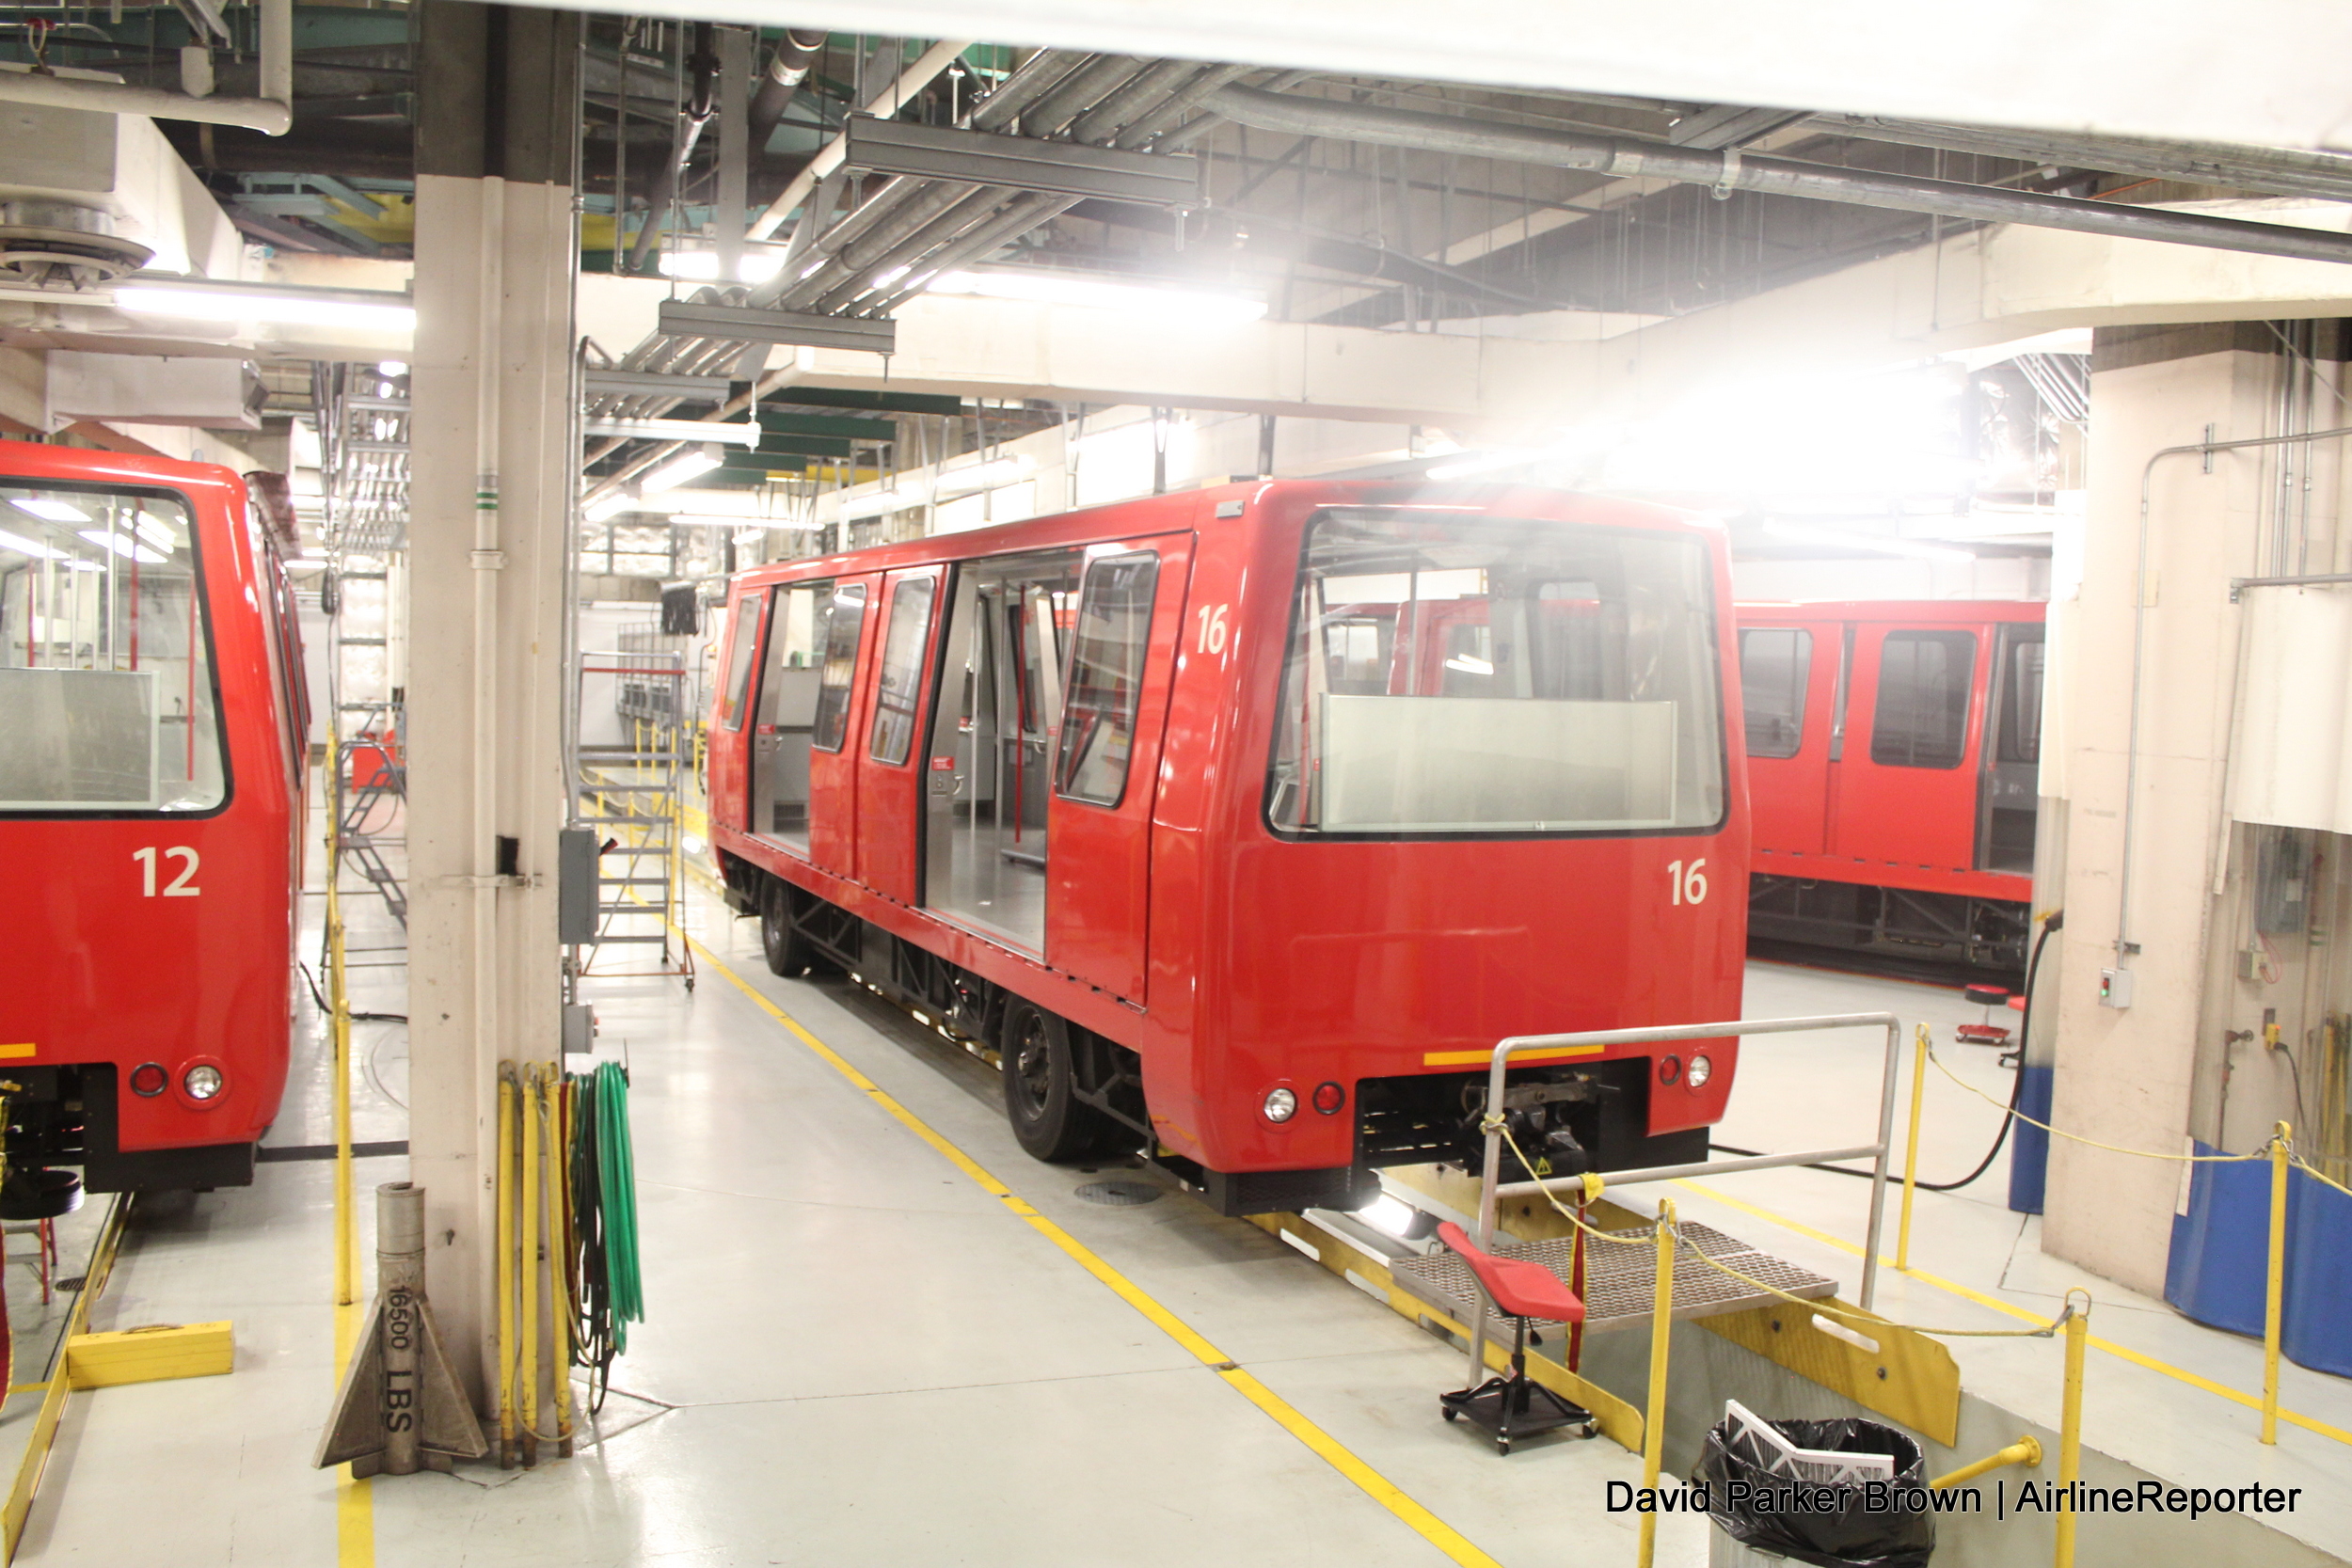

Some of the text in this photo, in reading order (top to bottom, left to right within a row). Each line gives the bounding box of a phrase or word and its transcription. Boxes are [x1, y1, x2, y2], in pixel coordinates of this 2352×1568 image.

[1197, 603, 1229, 655] 16
[133, 845, 201, 897] 12
[1667, 858, 1708, 906] 16
[386, 1285, 413, 1433] 16500 LBS
